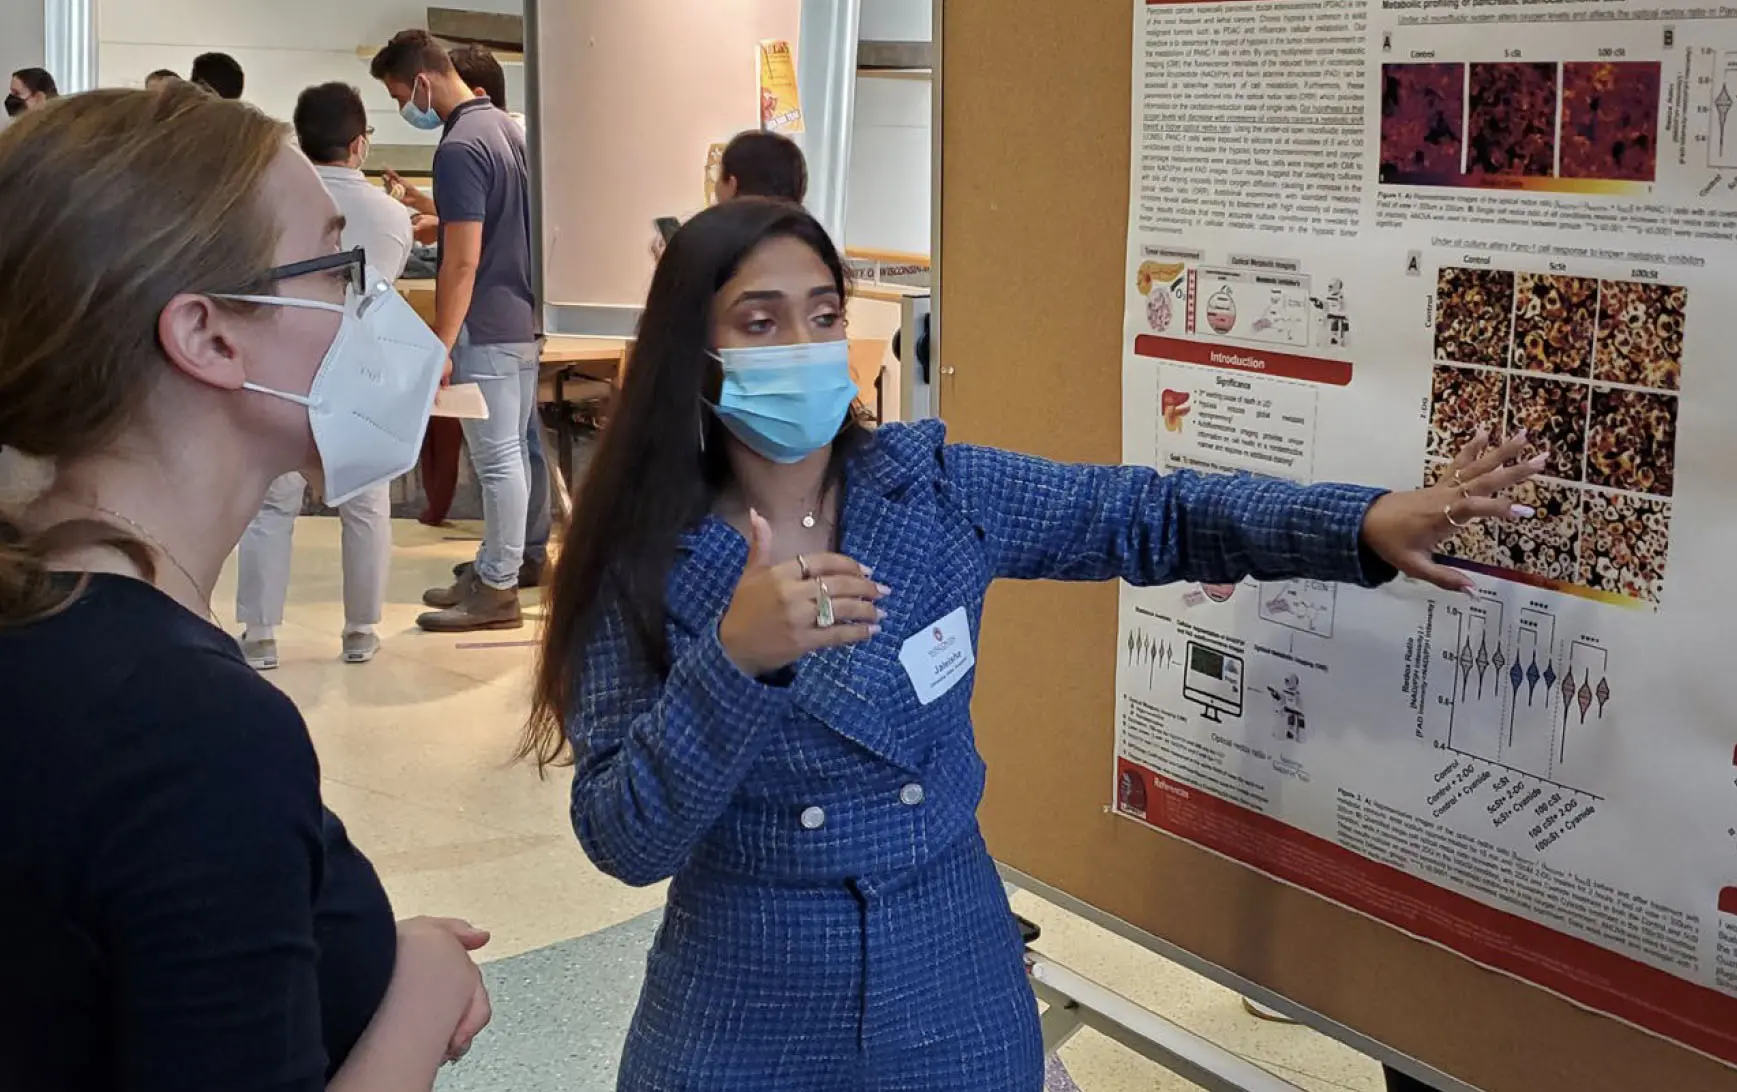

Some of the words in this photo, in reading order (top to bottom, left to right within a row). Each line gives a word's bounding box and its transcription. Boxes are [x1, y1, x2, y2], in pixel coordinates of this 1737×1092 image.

[1410, 50, 1436, 58] Control
[1408, 256, 1418, 271] A
[1463, 254, 1491, 265] Control
[1210, 350, 1265, 370] Introduction
[1215, 375, 1252, 390] Significance
[1446, 604, 1459, 616] 1.0
[1404, 636, 1414, 663] Ratio
[1401, 664, 1412, 693] Redox
[1433, 739, 1446, 750] 0.4
[1433, 758, 1460, 783] Control
[1426, 784, 1452, 806] Control
[1456, 764, 1475, 783] 2-DG
[1432, 795, 1458, 818] Control
[1462, 770, 1492, 795] Cyanide
[1506, 780, 1526, 800] 2-DG
[1512, 787, 1543, 813] Cyanide
[1534, 801, 1549, 816] 100
[1528, 824, 1543, 839] 100
[1558, 797, 1579, 818] 2-DG
[1564, 804, 1597, 831] Cyanide
